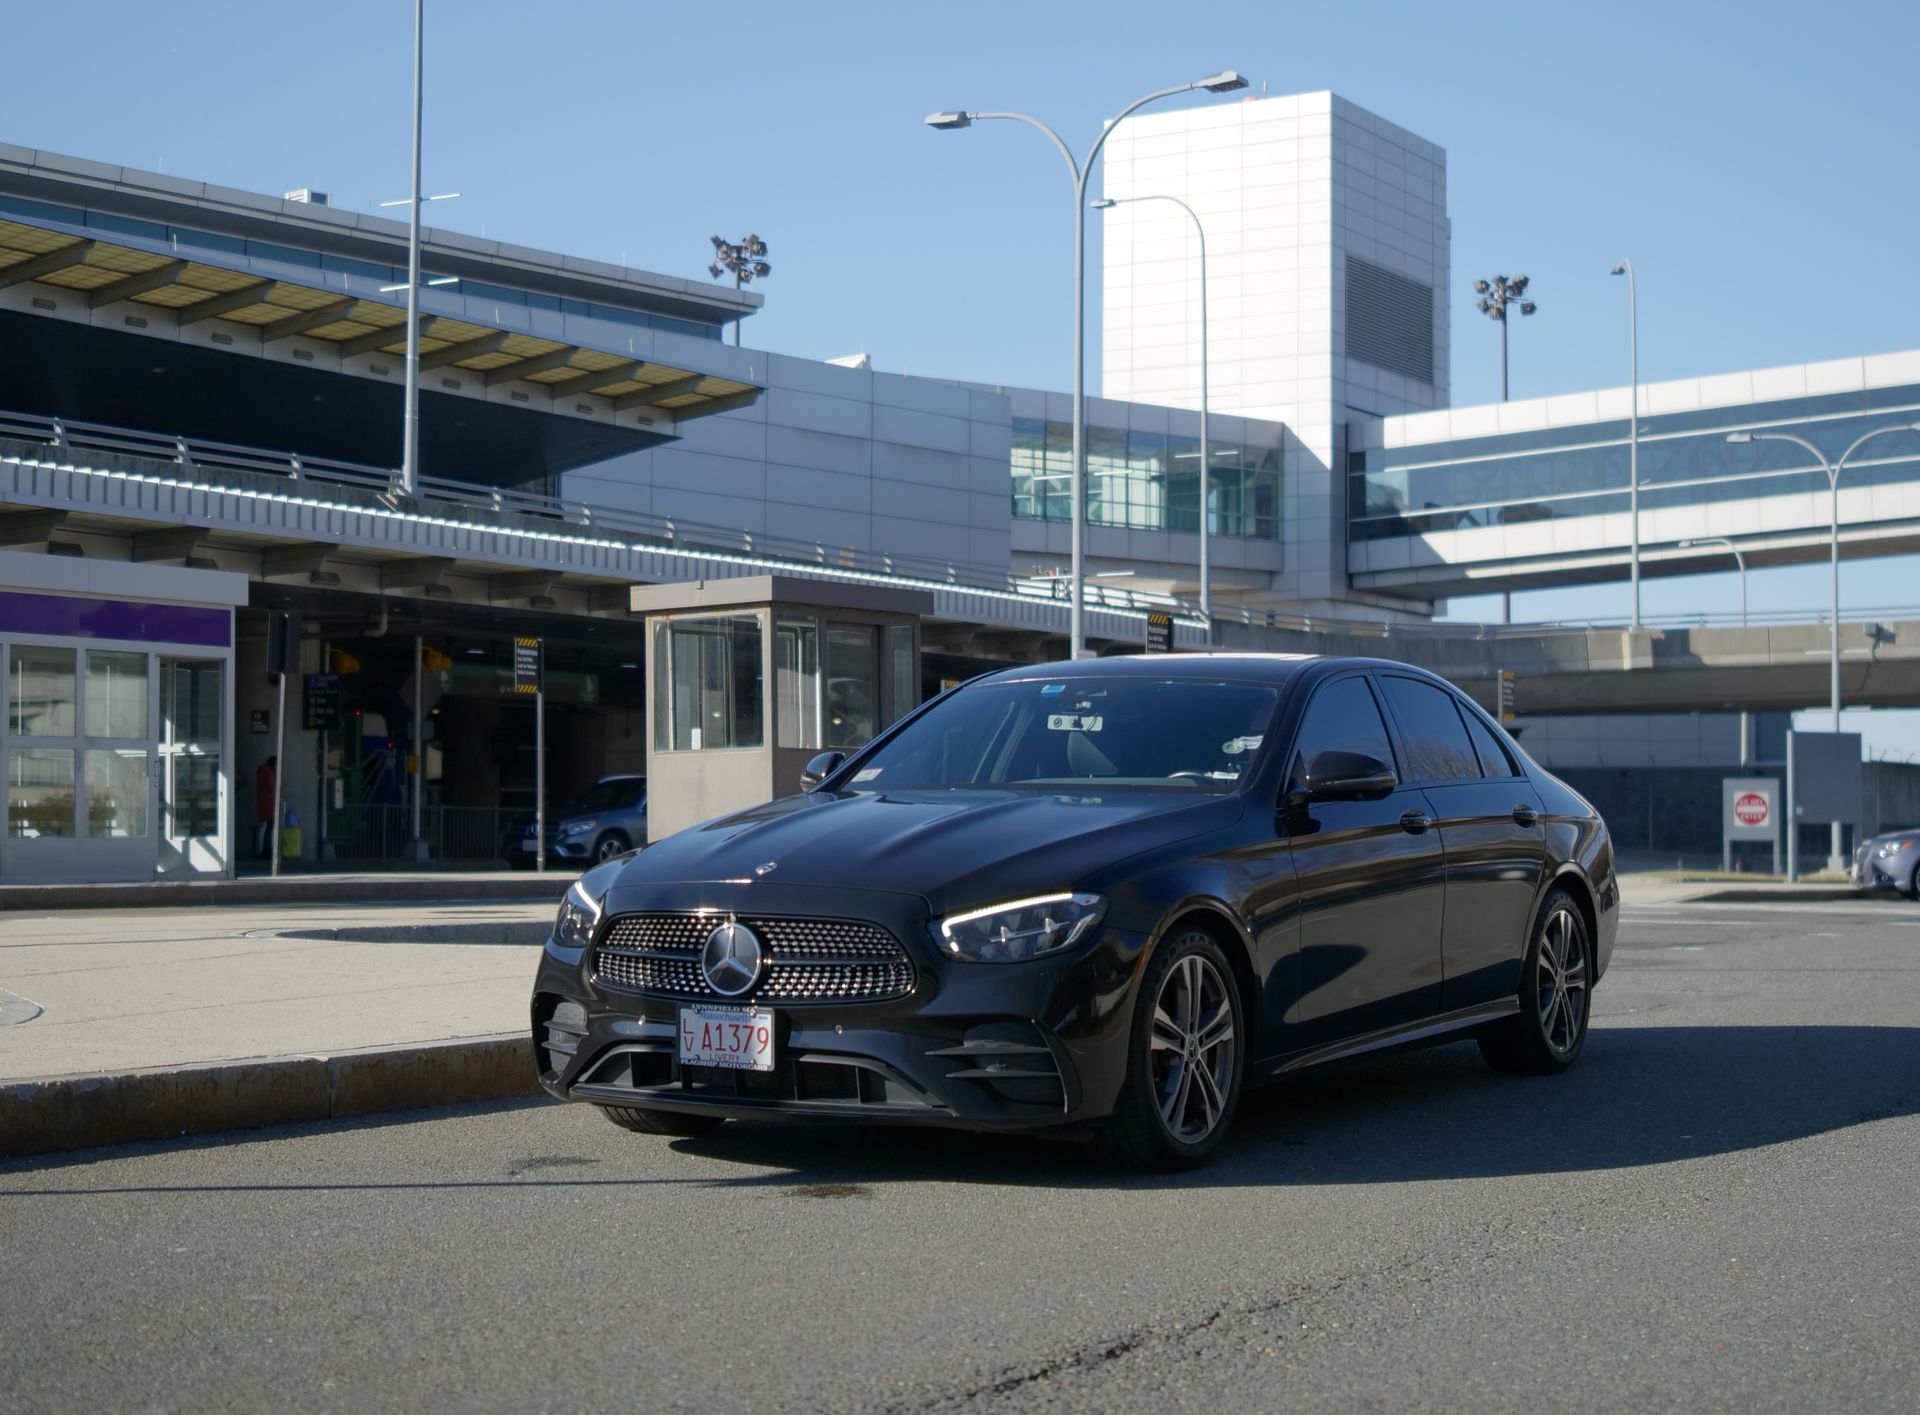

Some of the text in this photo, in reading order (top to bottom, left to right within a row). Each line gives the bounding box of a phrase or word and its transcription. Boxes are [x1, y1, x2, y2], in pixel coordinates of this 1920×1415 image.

[1740, 813, 1762, 821] ENTER
[691, 1004, 740, 1012] LYNNFIELD
[701, 1022, 769, 1054] A1379
[710, 1053, 740, 1062] LIVERY
[680, 1059, 768, 1071] FLAGSHIP MOTORCARS
